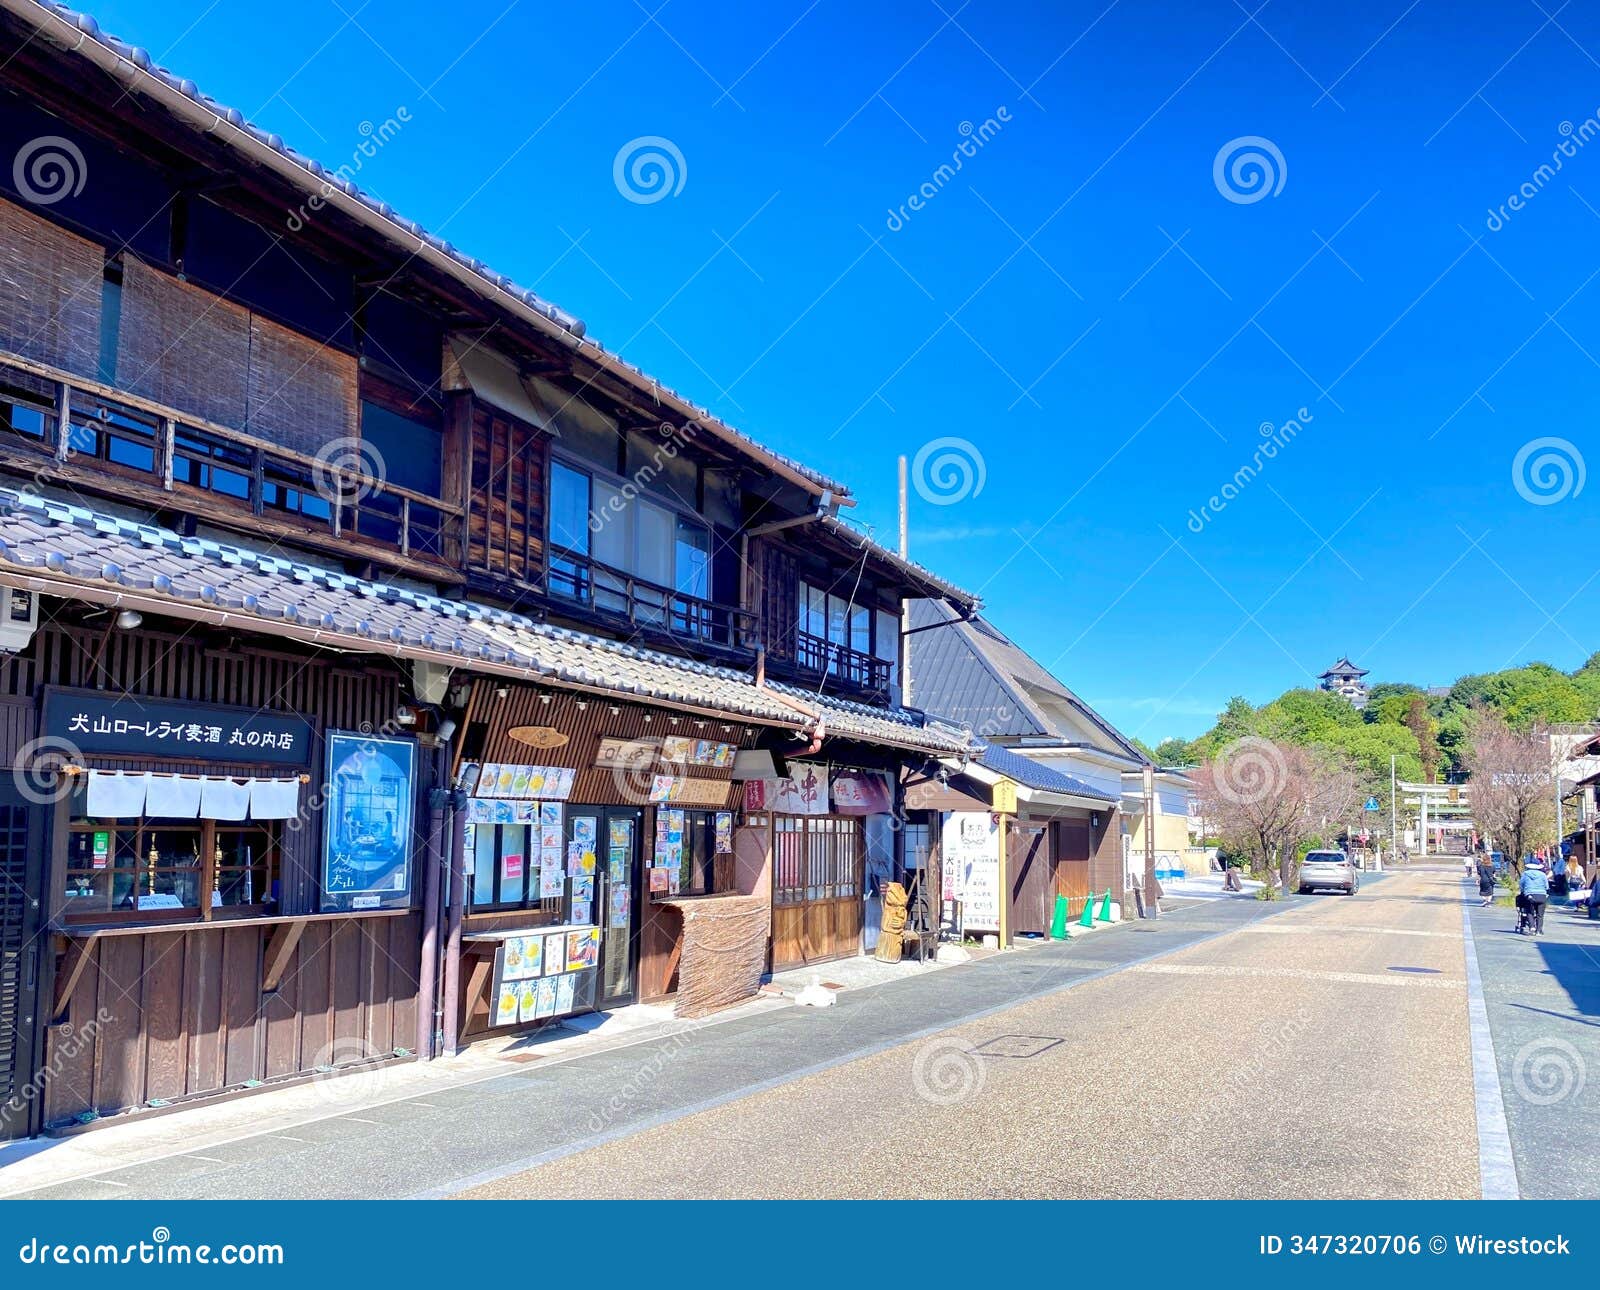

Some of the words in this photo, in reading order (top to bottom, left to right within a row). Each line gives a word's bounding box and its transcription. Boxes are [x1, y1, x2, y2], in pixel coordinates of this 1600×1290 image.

[68, 713, 223, 743] 犬山ローレライ麦酒
[228, 728, 294, 750] 丸の内店
